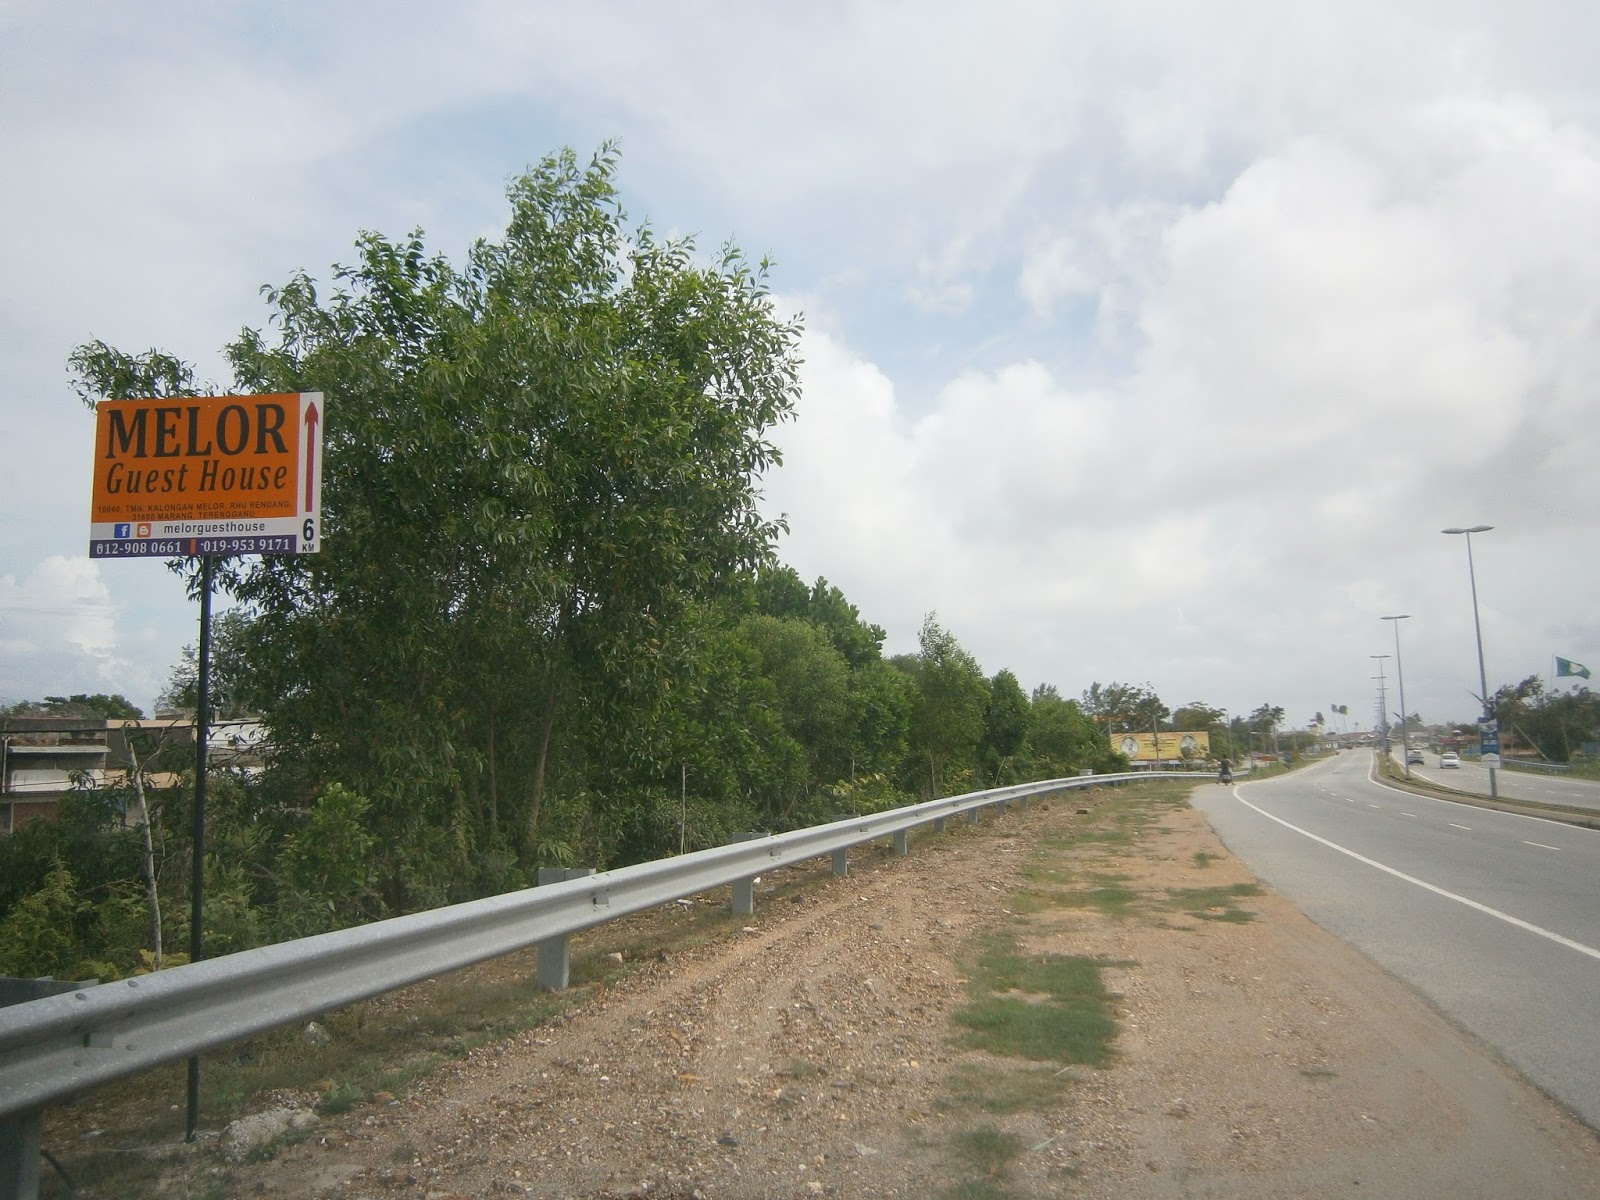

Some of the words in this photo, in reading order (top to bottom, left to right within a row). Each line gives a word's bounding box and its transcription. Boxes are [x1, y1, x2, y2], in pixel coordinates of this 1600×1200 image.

[105, 403, 289, 459] MELOR
[106, 462, 188, 495] Guest
[198, 460, 288, 492] House
[147, 503, 194, 512] KALONGAN
[230, 501, 247, 509] RHU
[164, 521, 266, 535] melorguesthouse
[302, 518, 315, 542] 6
[96, 542, 147, 555] 012-908
[151, 541, 182, 553] 0661
[203, 539, 255, 552] 019-953
[259, 538, 290, 551] 9171
[302, 543, 315, 552] KM
